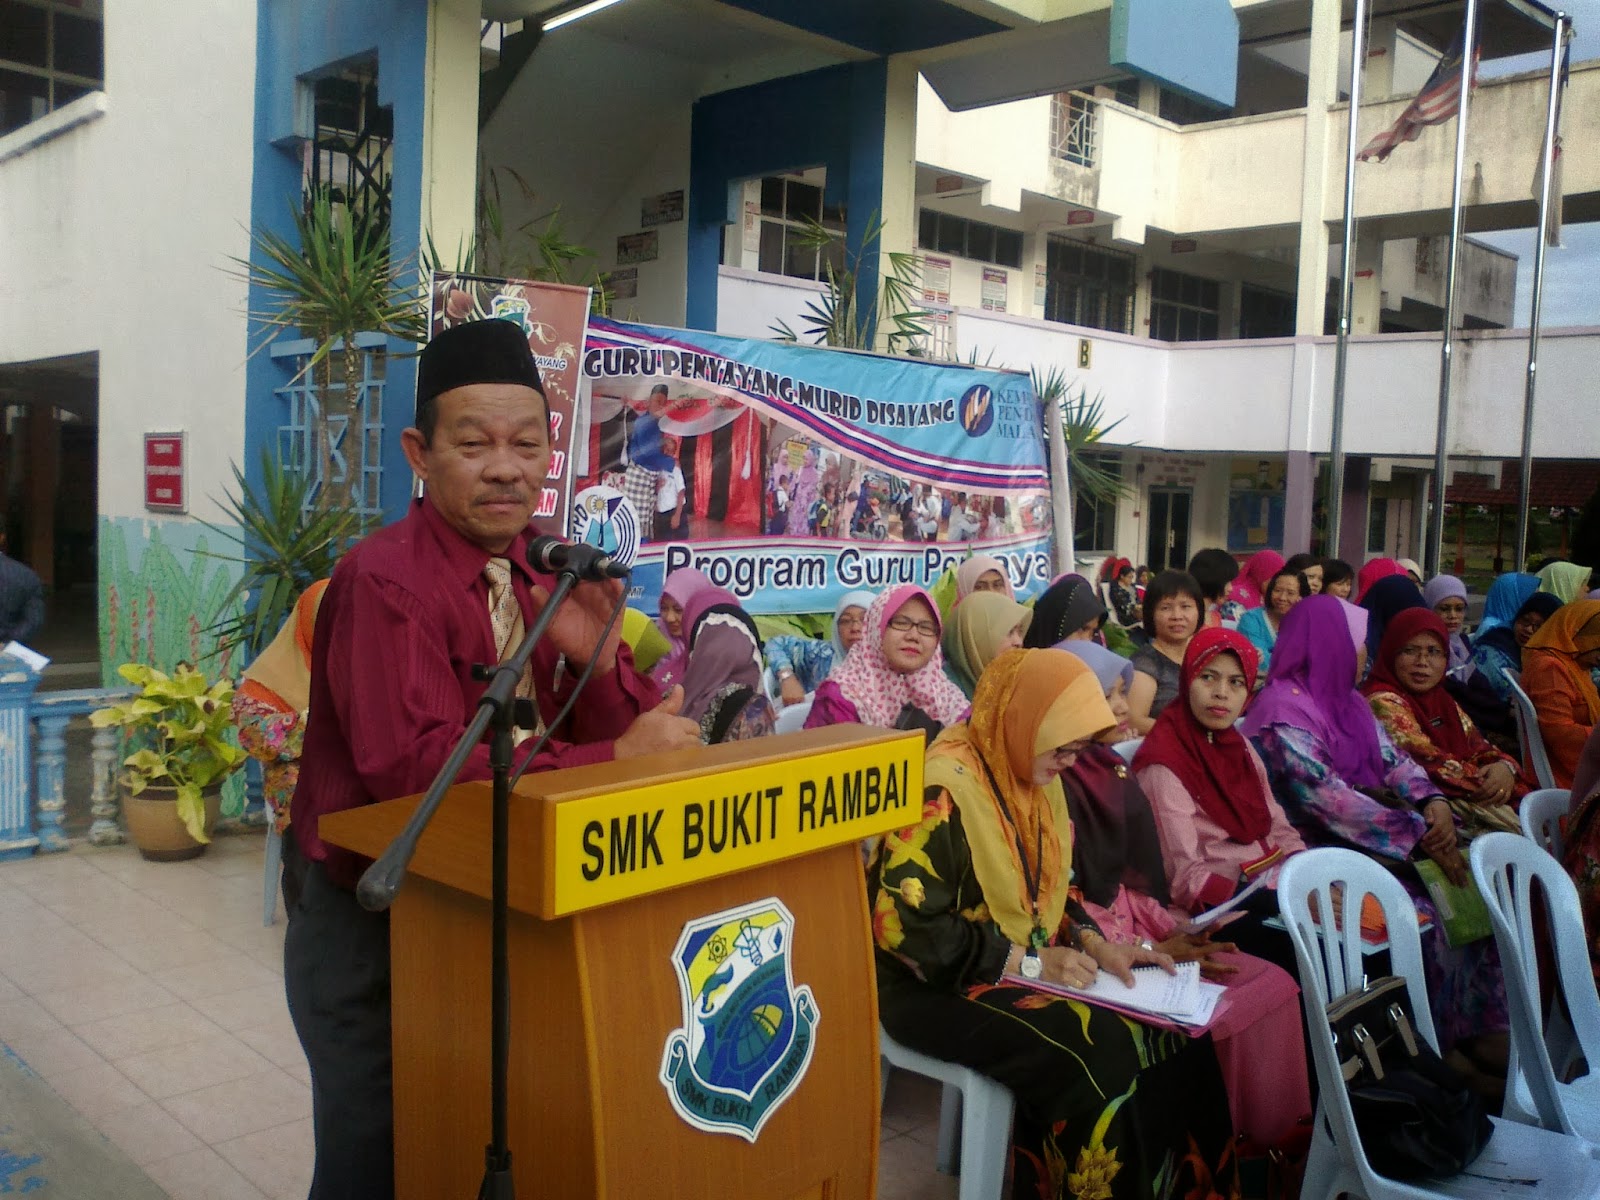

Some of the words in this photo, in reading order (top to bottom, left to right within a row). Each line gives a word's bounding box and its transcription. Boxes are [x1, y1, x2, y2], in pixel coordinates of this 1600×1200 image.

[1080, 339, 1089, 367] B
[584, 349, 656, 378] GURU
[799, 382, 861, 421] MURID
[867, 400, 954, 427] DISAYANG
[667, 546, 826, 597] Program
[837, 548, 914, 585] Guru
[581, 809, 664, 881] SMK
[683, 786, 783, 860] BUKIT
[799, 760, 909, 832] RAMBAI
